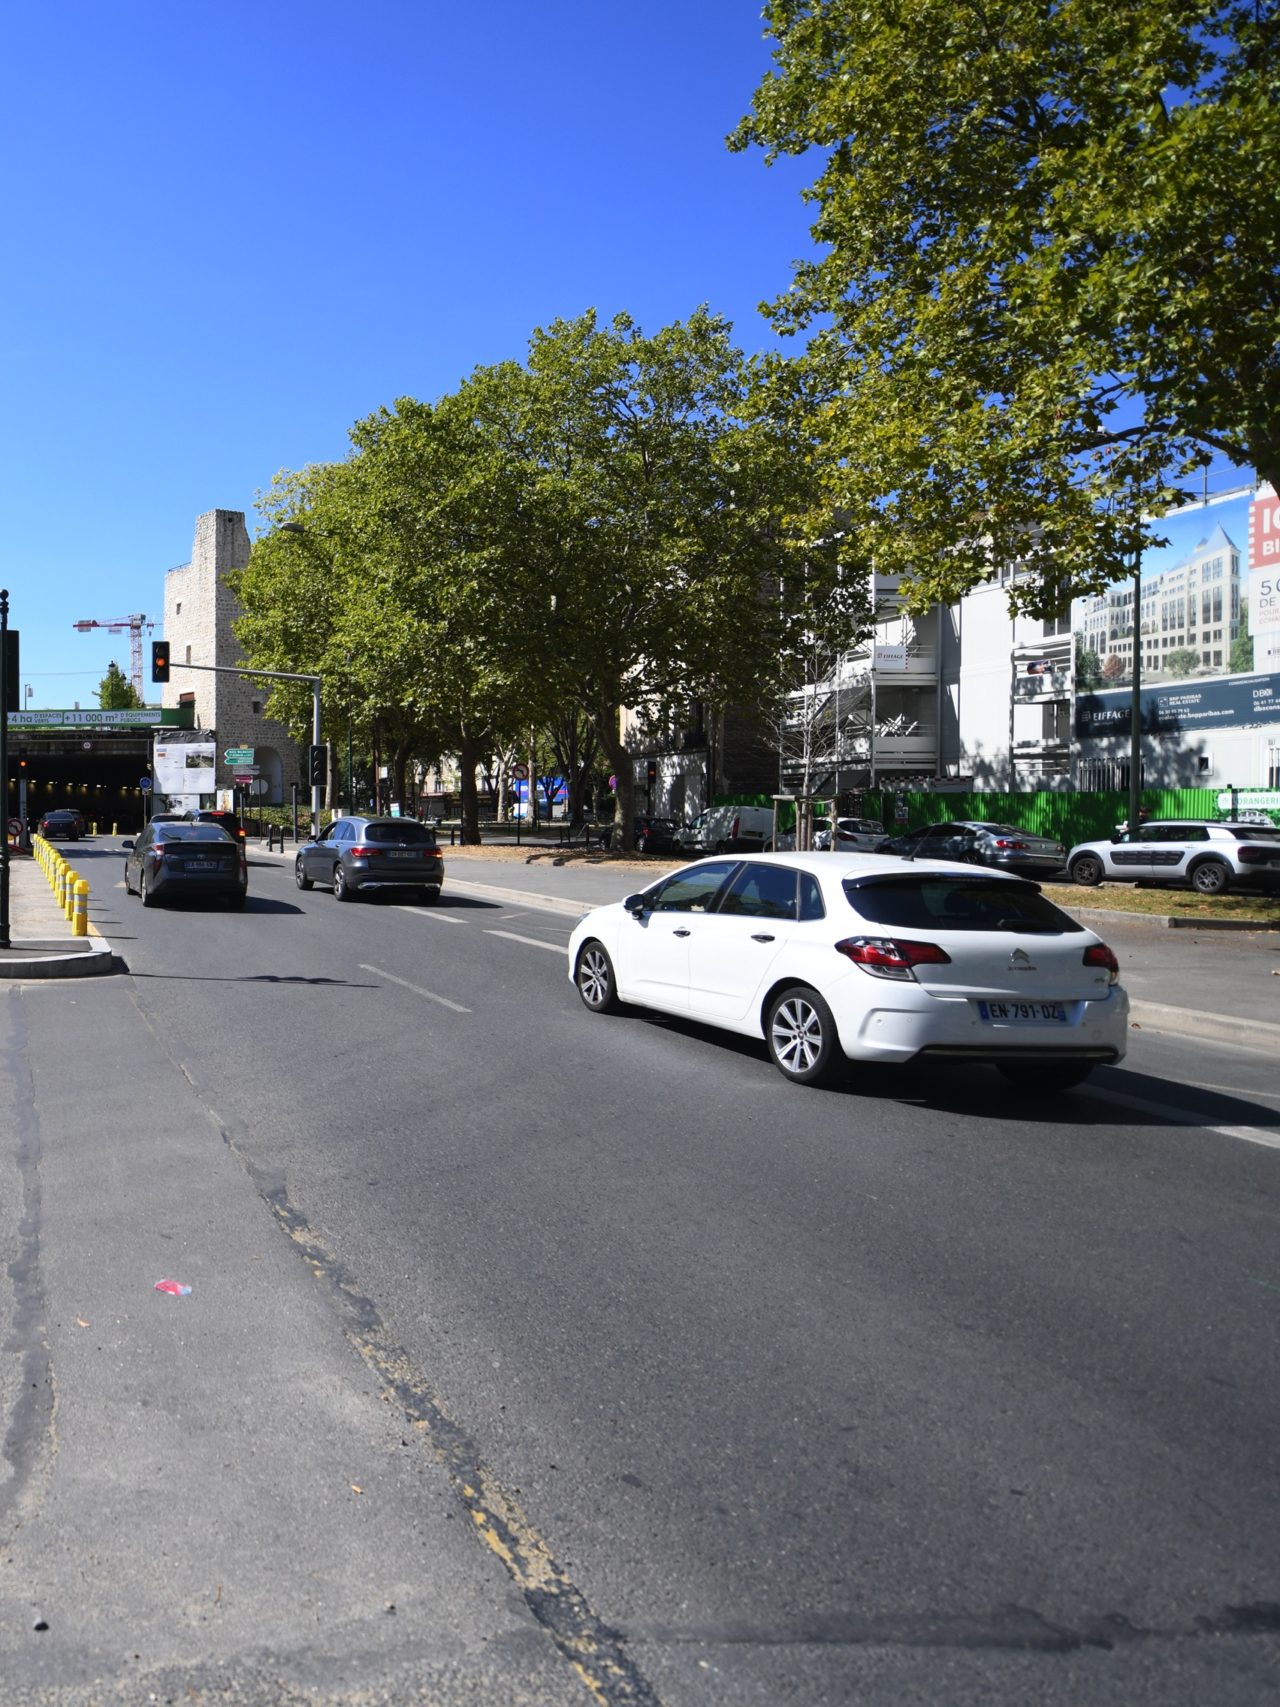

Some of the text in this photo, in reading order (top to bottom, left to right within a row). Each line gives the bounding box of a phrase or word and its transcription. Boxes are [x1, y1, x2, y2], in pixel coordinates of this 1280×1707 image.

[1260, 597, 1277, 608] DE
[20, 713, 33, 723] ha
[85, 713, 102, 722] 000
[1093, 709, 1130, 720] EIFFAGE
